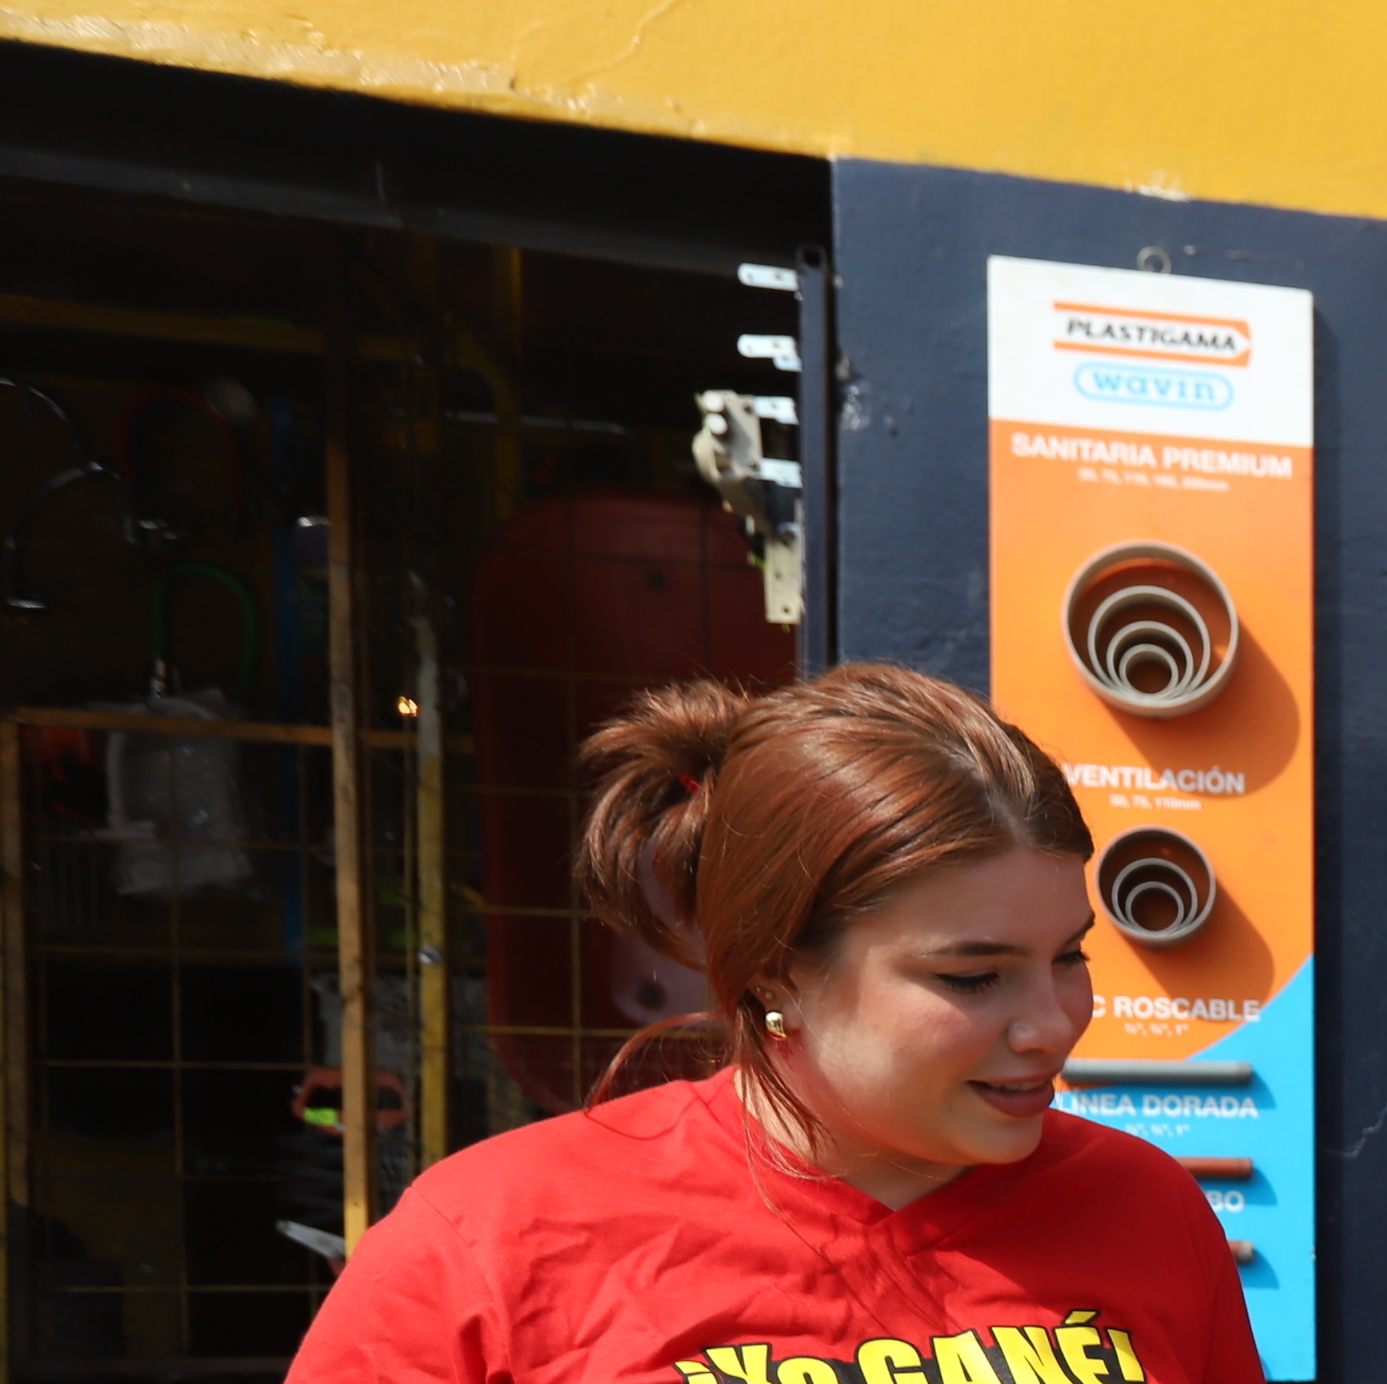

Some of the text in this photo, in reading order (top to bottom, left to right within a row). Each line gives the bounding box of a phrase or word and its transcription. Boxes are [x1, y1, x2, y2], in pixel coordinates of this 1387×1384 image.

[1066, 317, 1236, 354] PLASTIGAMA
[1091, 369, 1217, 403] wavin
[1011, 432, 1293, 479] SANITARIA PREMIUM
[1065, 763, 1245, 795] VENTILACIÓN
[1113, 996, 1261, 1022] ROSCABLE
[1142, 1095, 1259, 1118] DORADA
